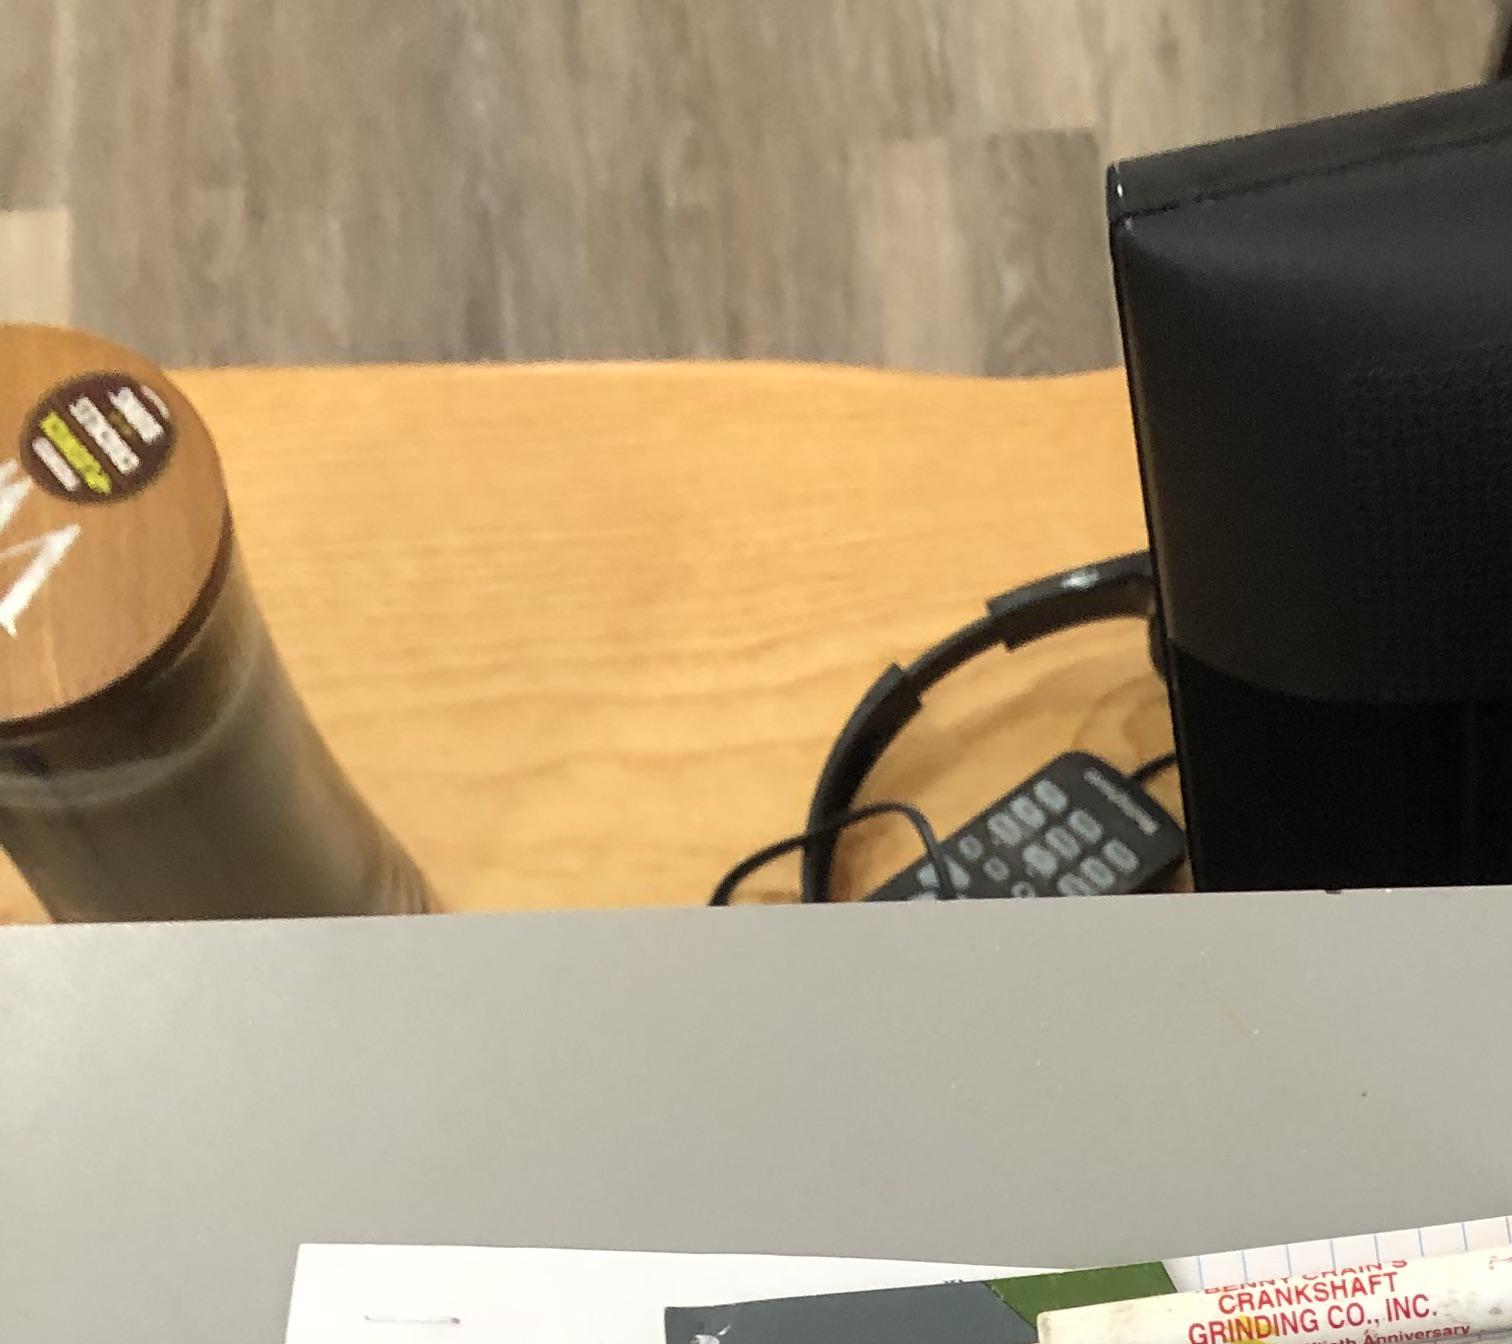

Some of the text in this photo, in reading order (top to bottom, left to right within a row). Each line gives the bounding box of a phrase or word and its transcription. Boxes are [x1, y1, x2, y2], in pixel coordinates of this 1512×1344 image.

[1217, 1271, 1399, 1315] CRANKSHAFT
[1327, 1301, 1380, 1330] CO.,
[1385, 1293, 1438, 1323] INC.
